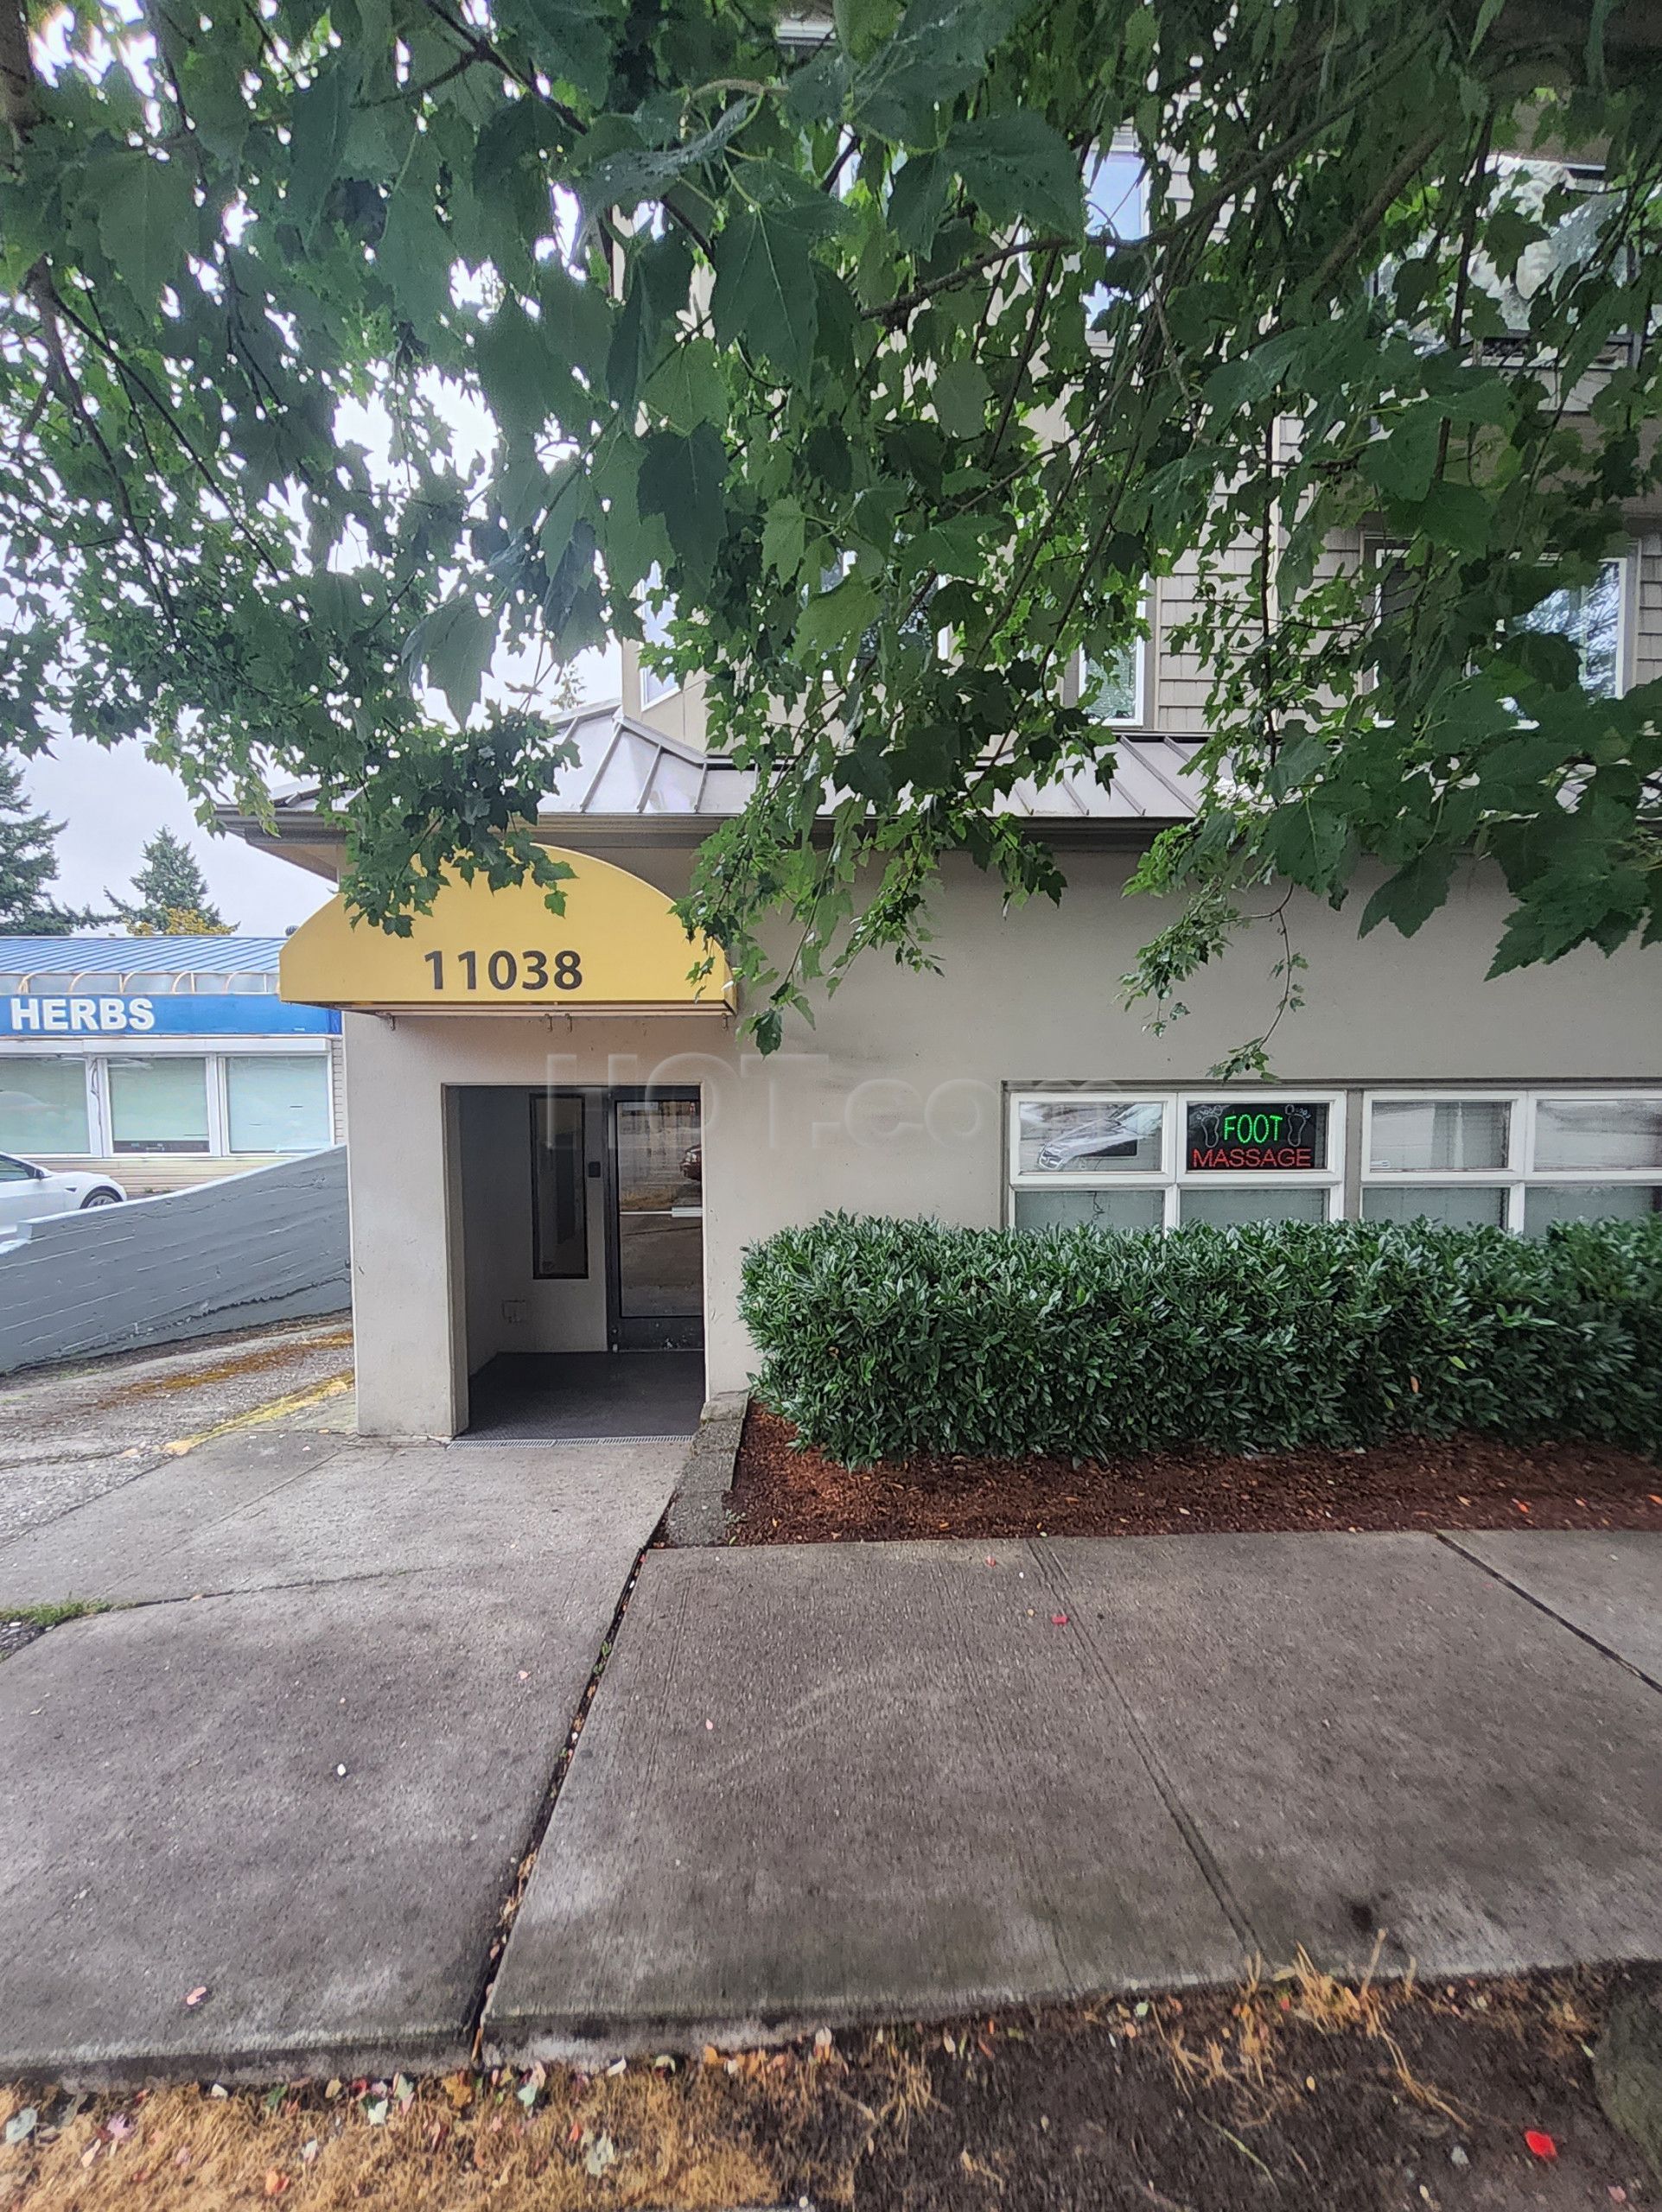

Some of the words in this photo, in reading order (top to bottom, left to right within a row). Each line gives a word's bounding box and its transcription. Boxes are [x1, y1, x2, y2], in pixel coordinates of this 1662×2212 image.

[424, 950, 583, 990] 11038
[10, 997, 155, 1031] HERBS
[1224, 1114, 1283, 1143] FOOT
[1192, 1147, 1312, 1167] MASSAGE
